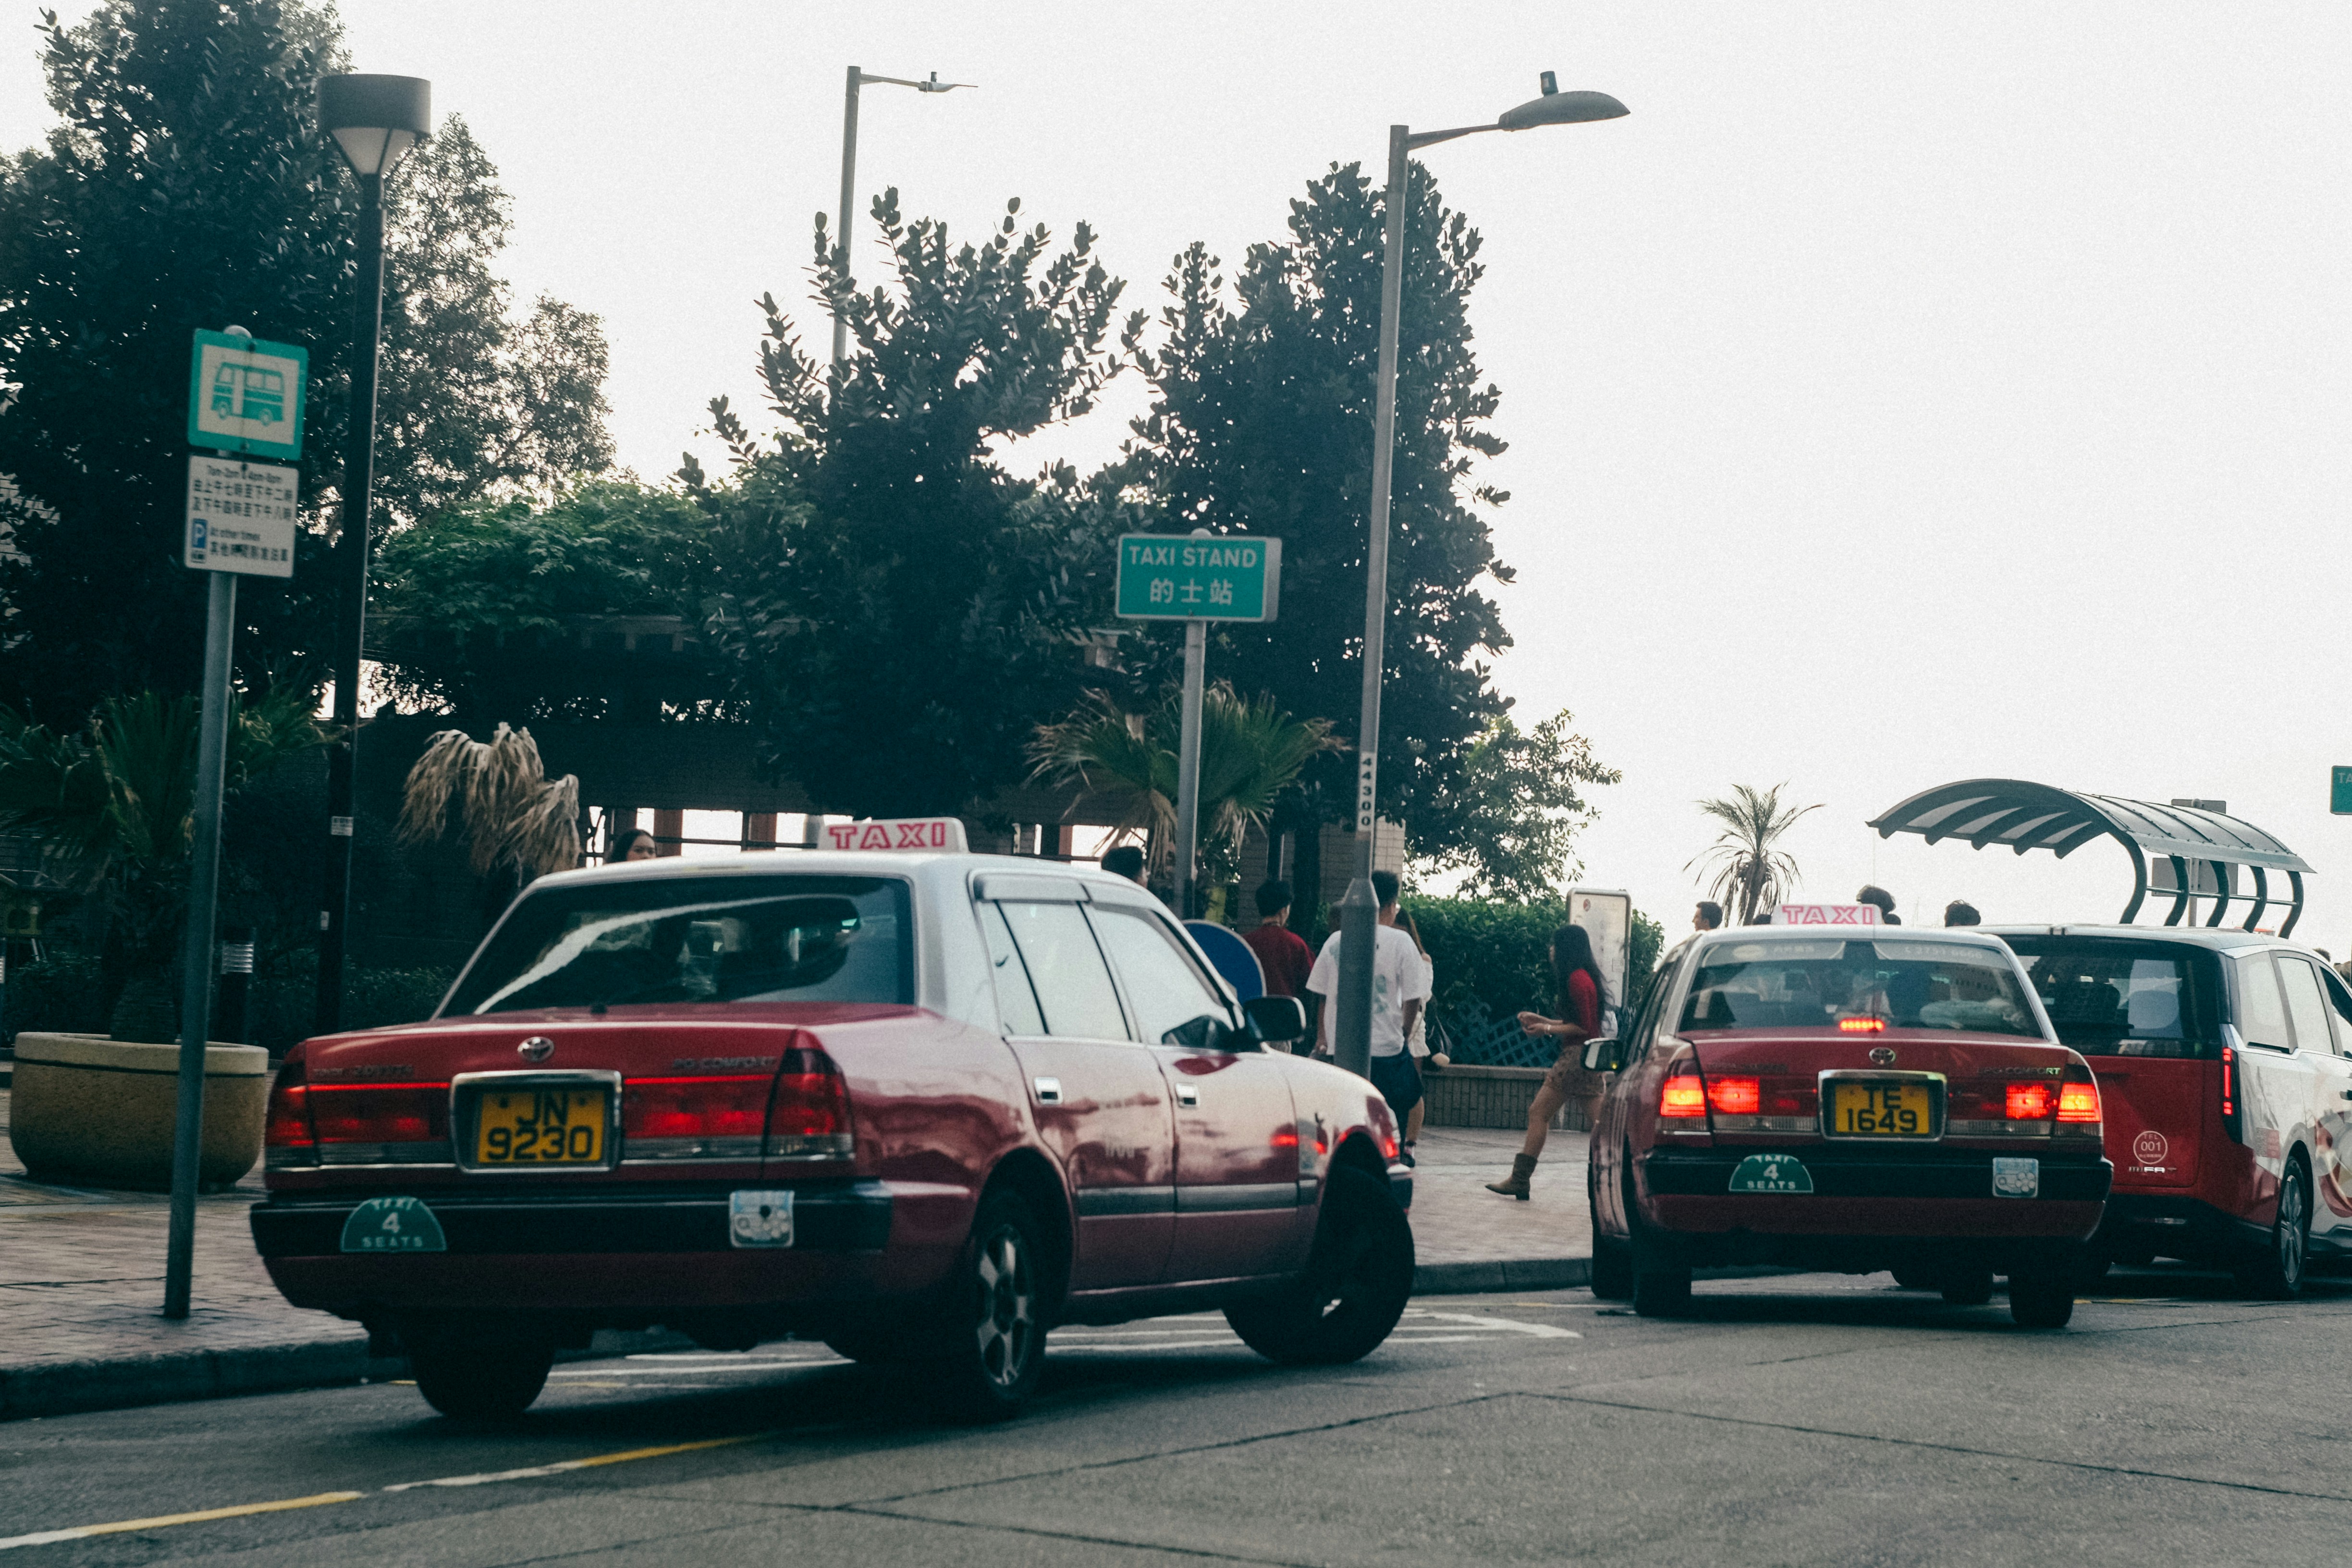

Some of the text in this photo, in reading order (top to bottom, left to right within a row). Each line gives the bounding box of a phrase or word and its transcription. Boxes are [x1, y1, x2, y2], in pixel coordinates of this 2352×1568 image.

[1129, 546, 1257, 568] TAXI STAND
[1150, 577, 1234, 605] 的士站
[829, 822, 945, 849] TAXI
[1782, 906, 1874, 925] TAXI
[2005, 1067, 2060, 1075] COMFORT
[1862, 1084, 1901, 1109] TE
[516, 1090, 569, 1126] JN
[1847, 1108, 1917, 1131] 1649
[487, 1125, 594, 1160] 9230
[2141, 1141, 2161, 1151] 001
[1764, 1164, 1779, 1180] 4
[1747, 1180, 1795, 1189] SEATS
[382, 1212, 401, 1233] 4
[362, 1236, 423, 1247] SEATS
